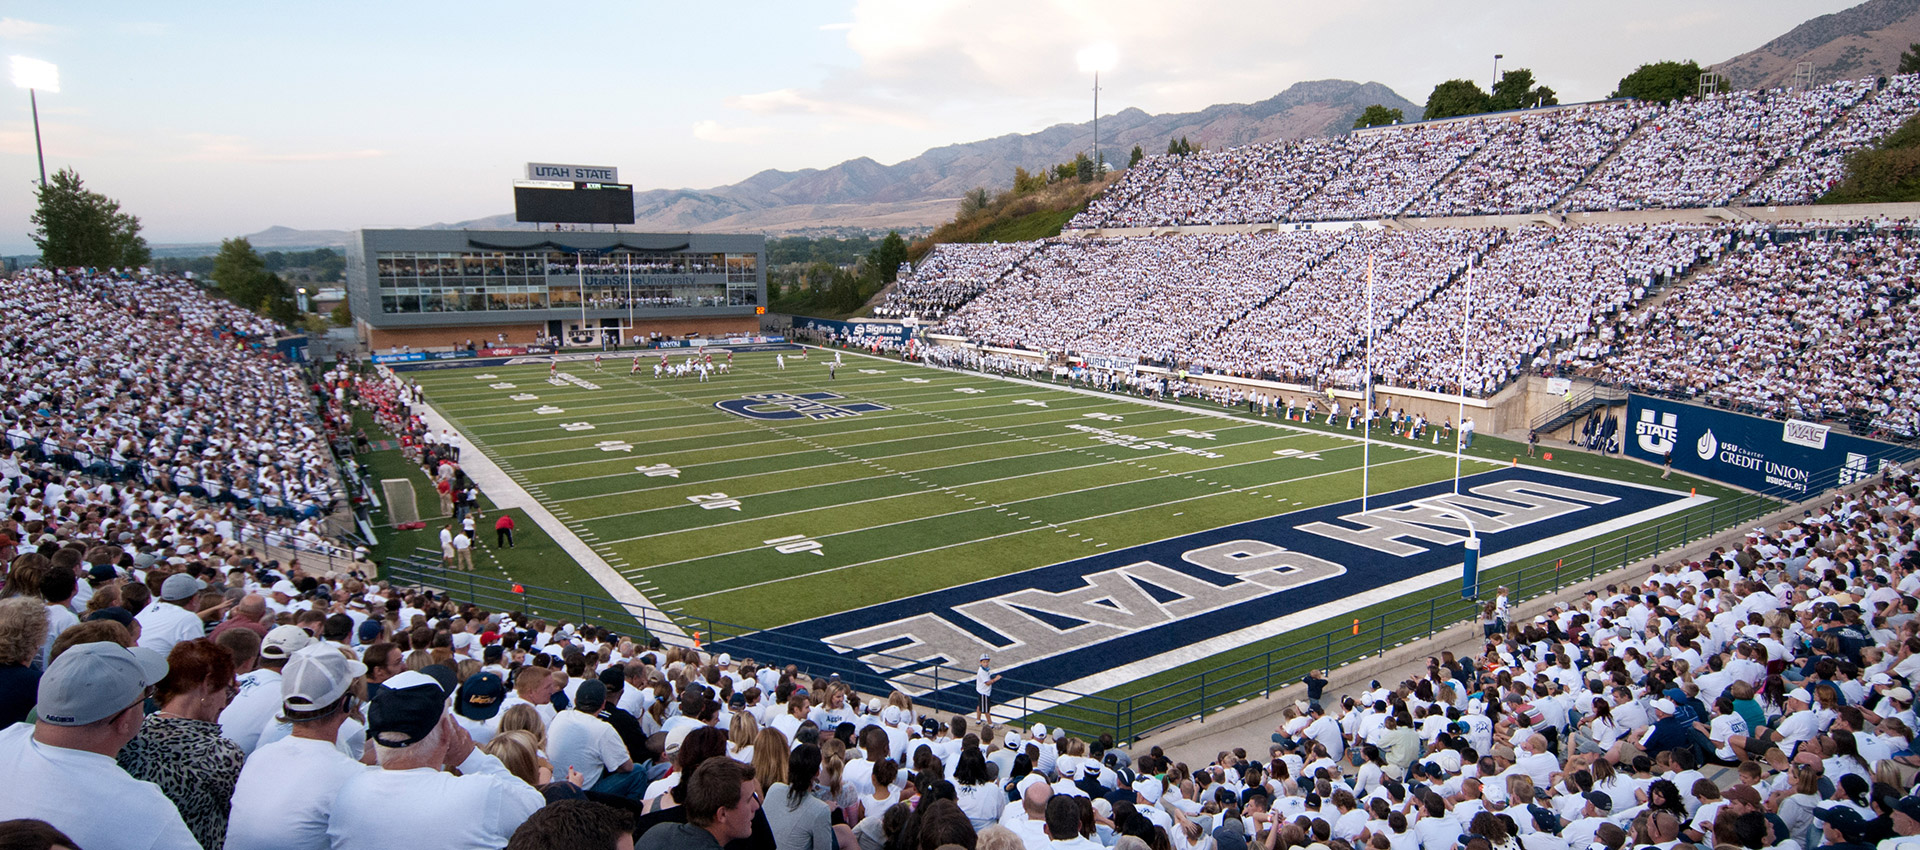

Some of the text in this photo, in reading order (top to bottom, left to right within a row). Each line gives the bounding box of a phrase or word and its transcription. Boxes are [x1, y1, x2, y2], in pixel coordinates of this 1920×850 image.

[535, 166, 612, 180] UTAH STATE
[584, 275, 696, 286] UtahStteUniversity
[756, 306, 766, 315] 22
[568, 330, 596, 338] STATE
[865, 323, 903, 335] Sign Pro
[741, 392, 863, 420] STATE
[1635, 421, 1678, 443] STATE
[1787, 422, 1826, 443] WAC
[1273, 448, 1321, 459] 10
[1721, 441, 1764, 459] USU Charter
[635, 463, 681, 477] 30
[1719, 450, 1810, 483] CREDIT UNION
[686, 492, 740, 511] 20
[763, 534, 823, 556] 10
[819, 479, 1622, 697] UTAH STATE
[1785, 590, 1793, 605] 9
[826, 715, 843, 723] Aggie
